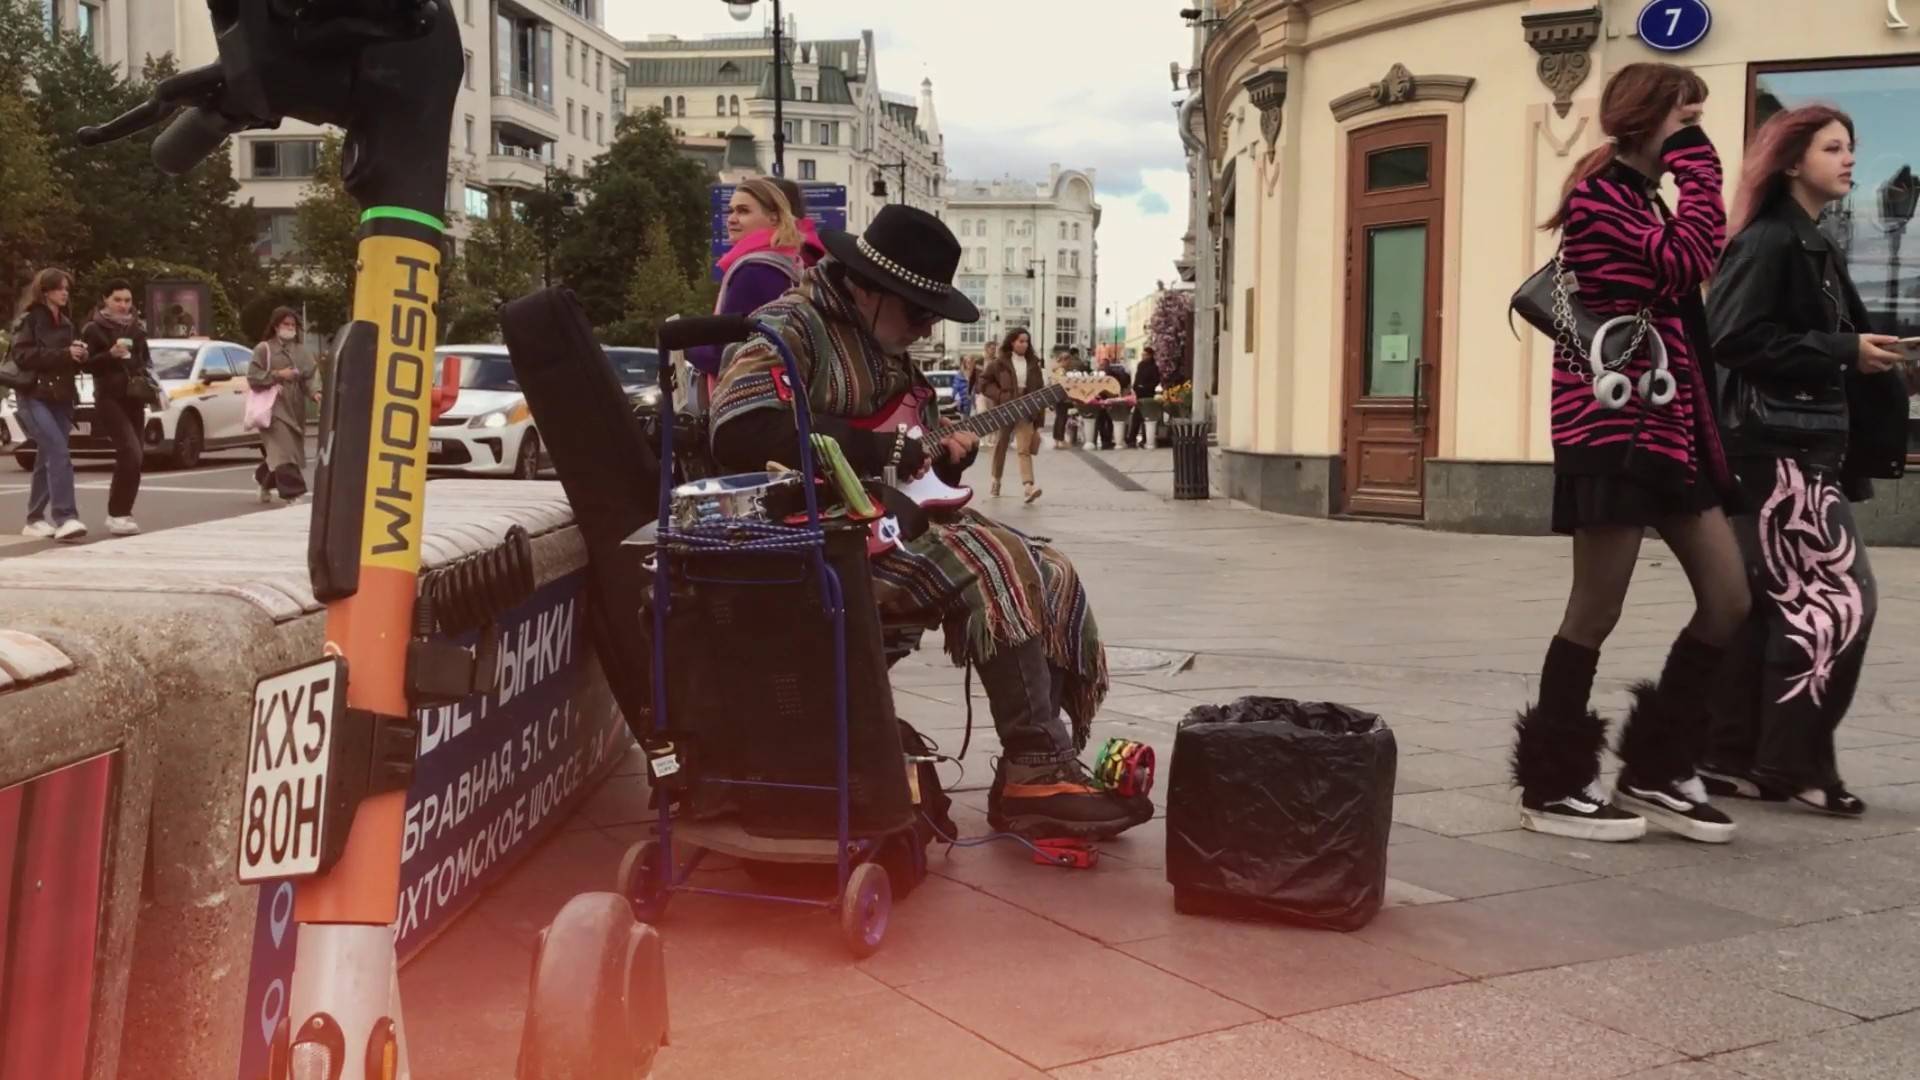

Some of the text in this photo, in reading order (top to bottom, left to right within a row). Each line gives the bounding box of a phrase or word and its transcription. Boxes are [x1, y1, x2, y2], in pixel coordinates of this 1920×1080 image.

[1664, 8, 1682, 36] 7
[371, 255, 431, 555] WHOOSH
[252, 678, 330, 774] KX5
[246, 774, 322, 864] 80H
